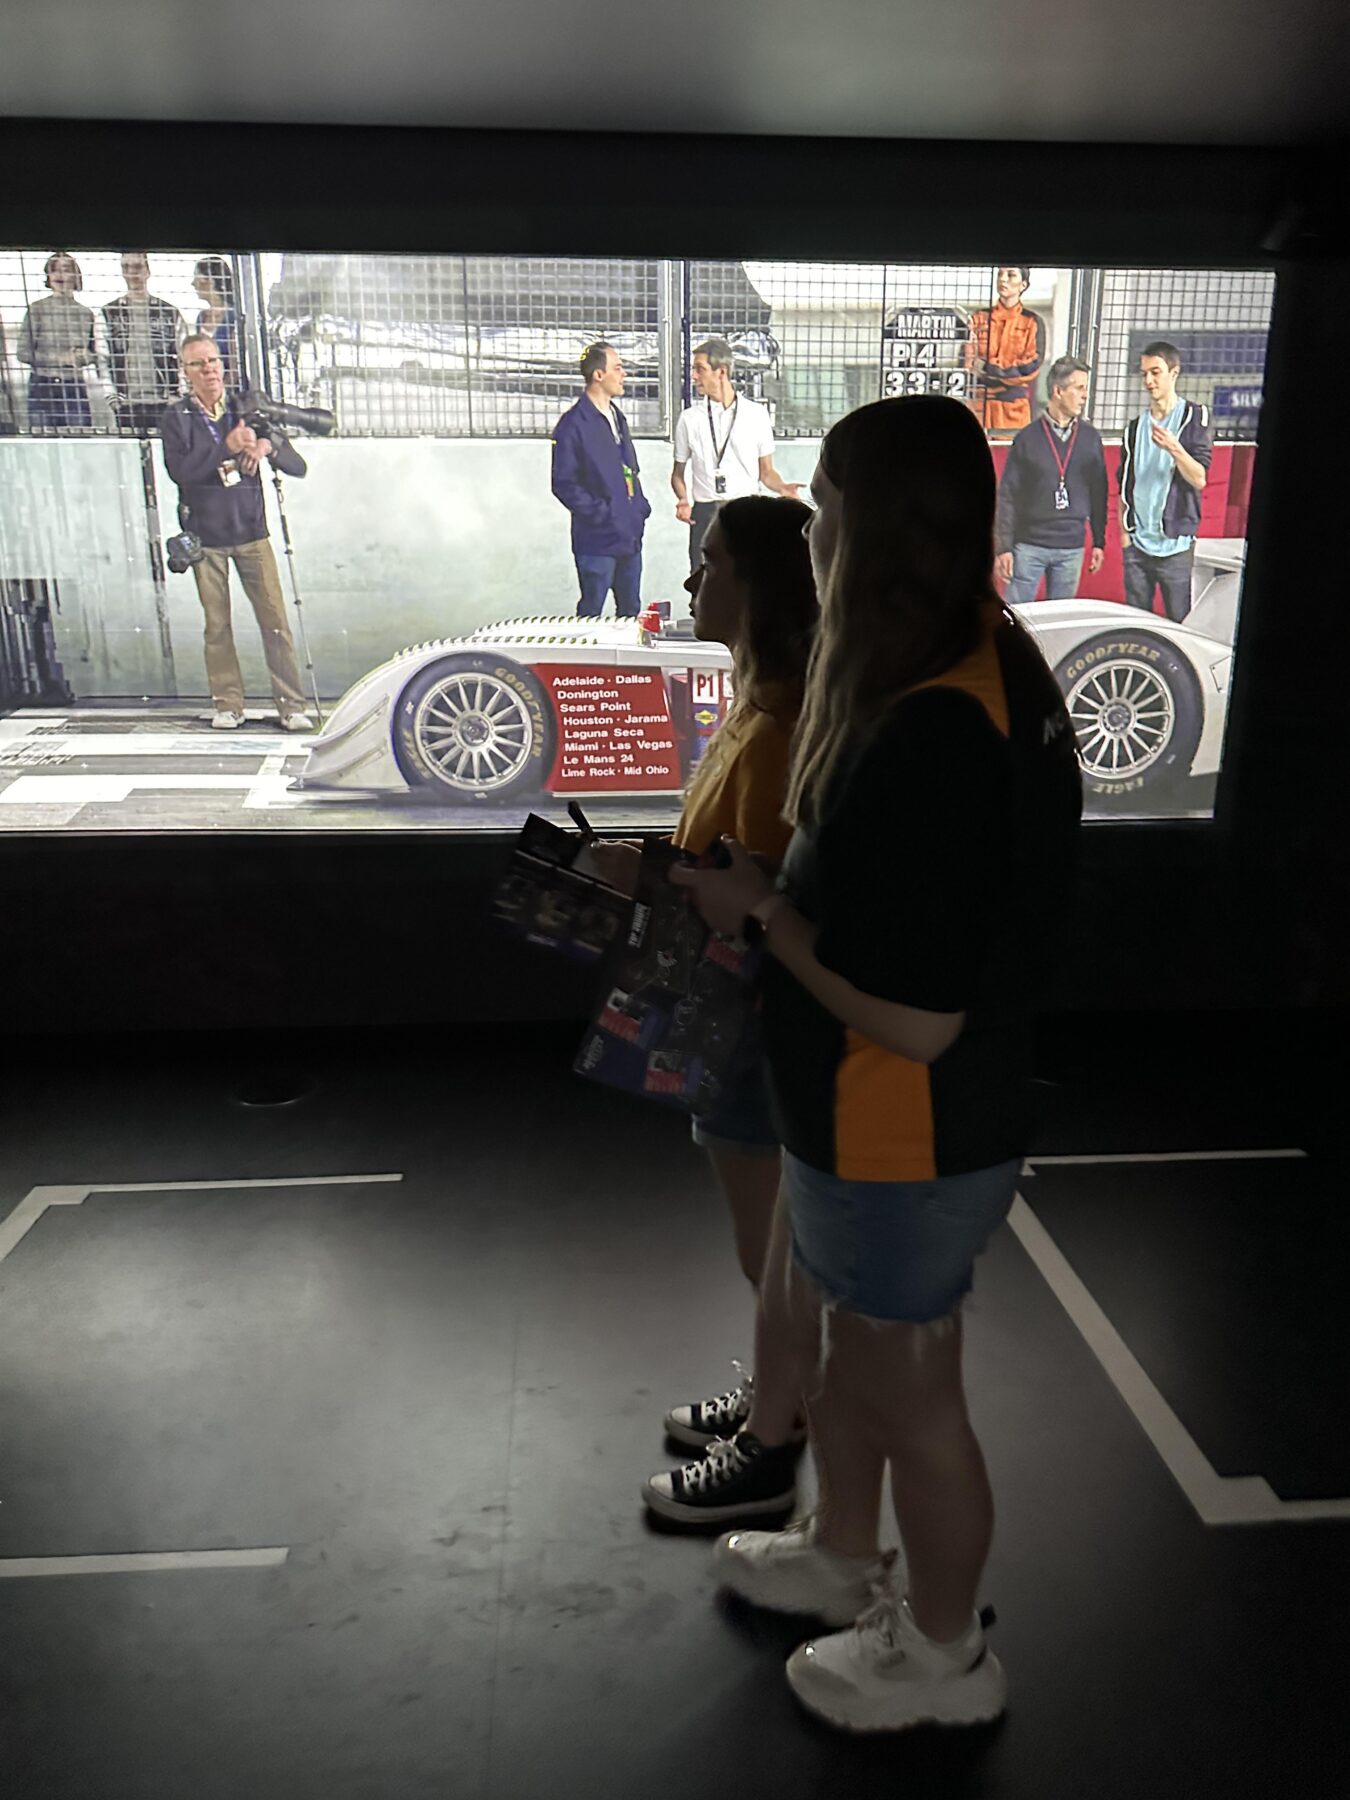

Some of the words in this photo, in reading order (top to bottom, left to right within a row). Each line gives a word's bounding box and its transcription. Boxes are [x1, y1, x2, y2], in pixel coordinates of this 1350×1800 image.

[897, 314, 957, 338] MARTIN
[1067, 642, 1160, 679] GOODYEAR
[552, 677, 605, 686] Adelaide
[615, 675, 652, 684] Dallas
[697, 673, 714, 697] P1
[557, 690, 619, 700] Donington
[494, 667, 544, 757] GOODYEAR
[560, 703, 595, 712] Sears
[600, 702, 631, 711] Point
[563, 716, 613, 725] Houston
[624, 714, 668, 724] Jarama
[564, 729, 608, 740] Laguna
[613, 728, 644, 737] Seca
[565, 742, 599, 751] Miami
[609, 741, 631, 750] Las
[637, 740, 673, 751] Vegas
[563, 755, 579, 765] Le
[583, 755, 616, 764] Mans
[620, 754, 635, 763] 24
[561, 768, 586, 777] Lime
[589, 767, 615, 777] Rock
[624, 766, 642, 775] Mid
[646, 766, 669, 775] Ohio
